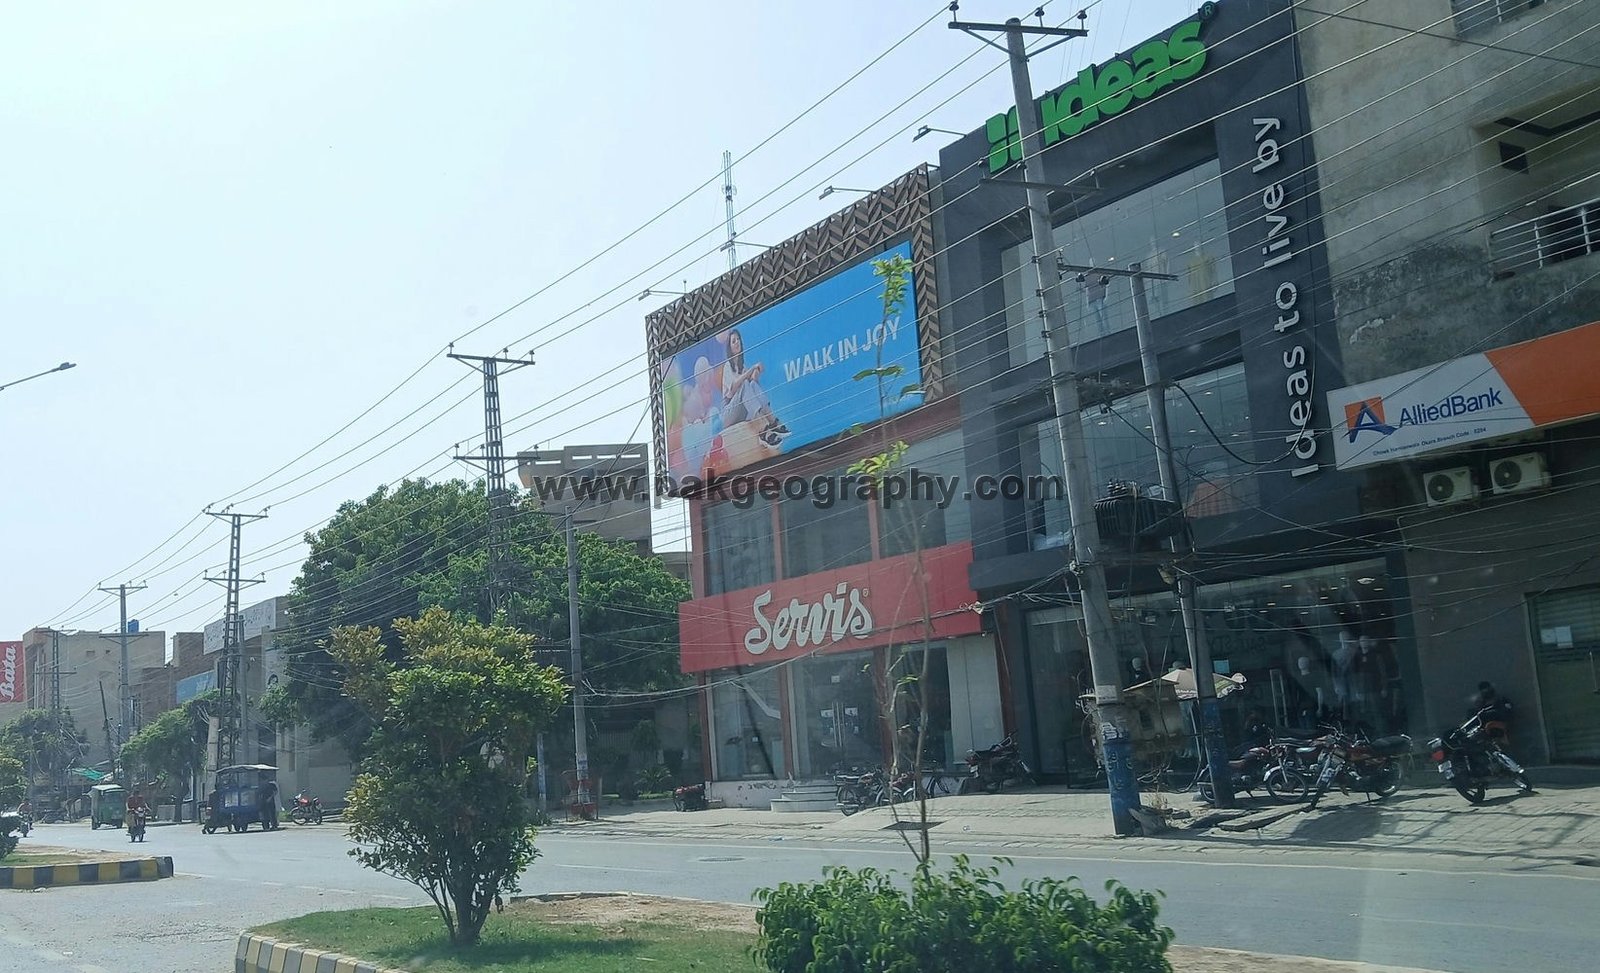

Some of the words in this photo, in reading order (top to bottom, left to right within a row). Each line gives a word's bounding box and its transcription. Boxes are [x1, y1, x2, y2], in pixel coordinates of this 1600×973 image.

[1041, 21, 1207, 145] ideas
[1252, 117, 1281, 173] by
[1262, 183, 1292, 268] live
[1273, 281, 1299, 333] to
[783, 346, 835, 383] WALK
[836, 335, 859, 358] IN
[862, 317, 901, 352] JOY
[1284, 345, 1319, 477] Ideas
[1400, 387, 1503, 428] AlliedBank
[744, 581, 872, 655] Servis
[0, 645, 16, 700] Bata
